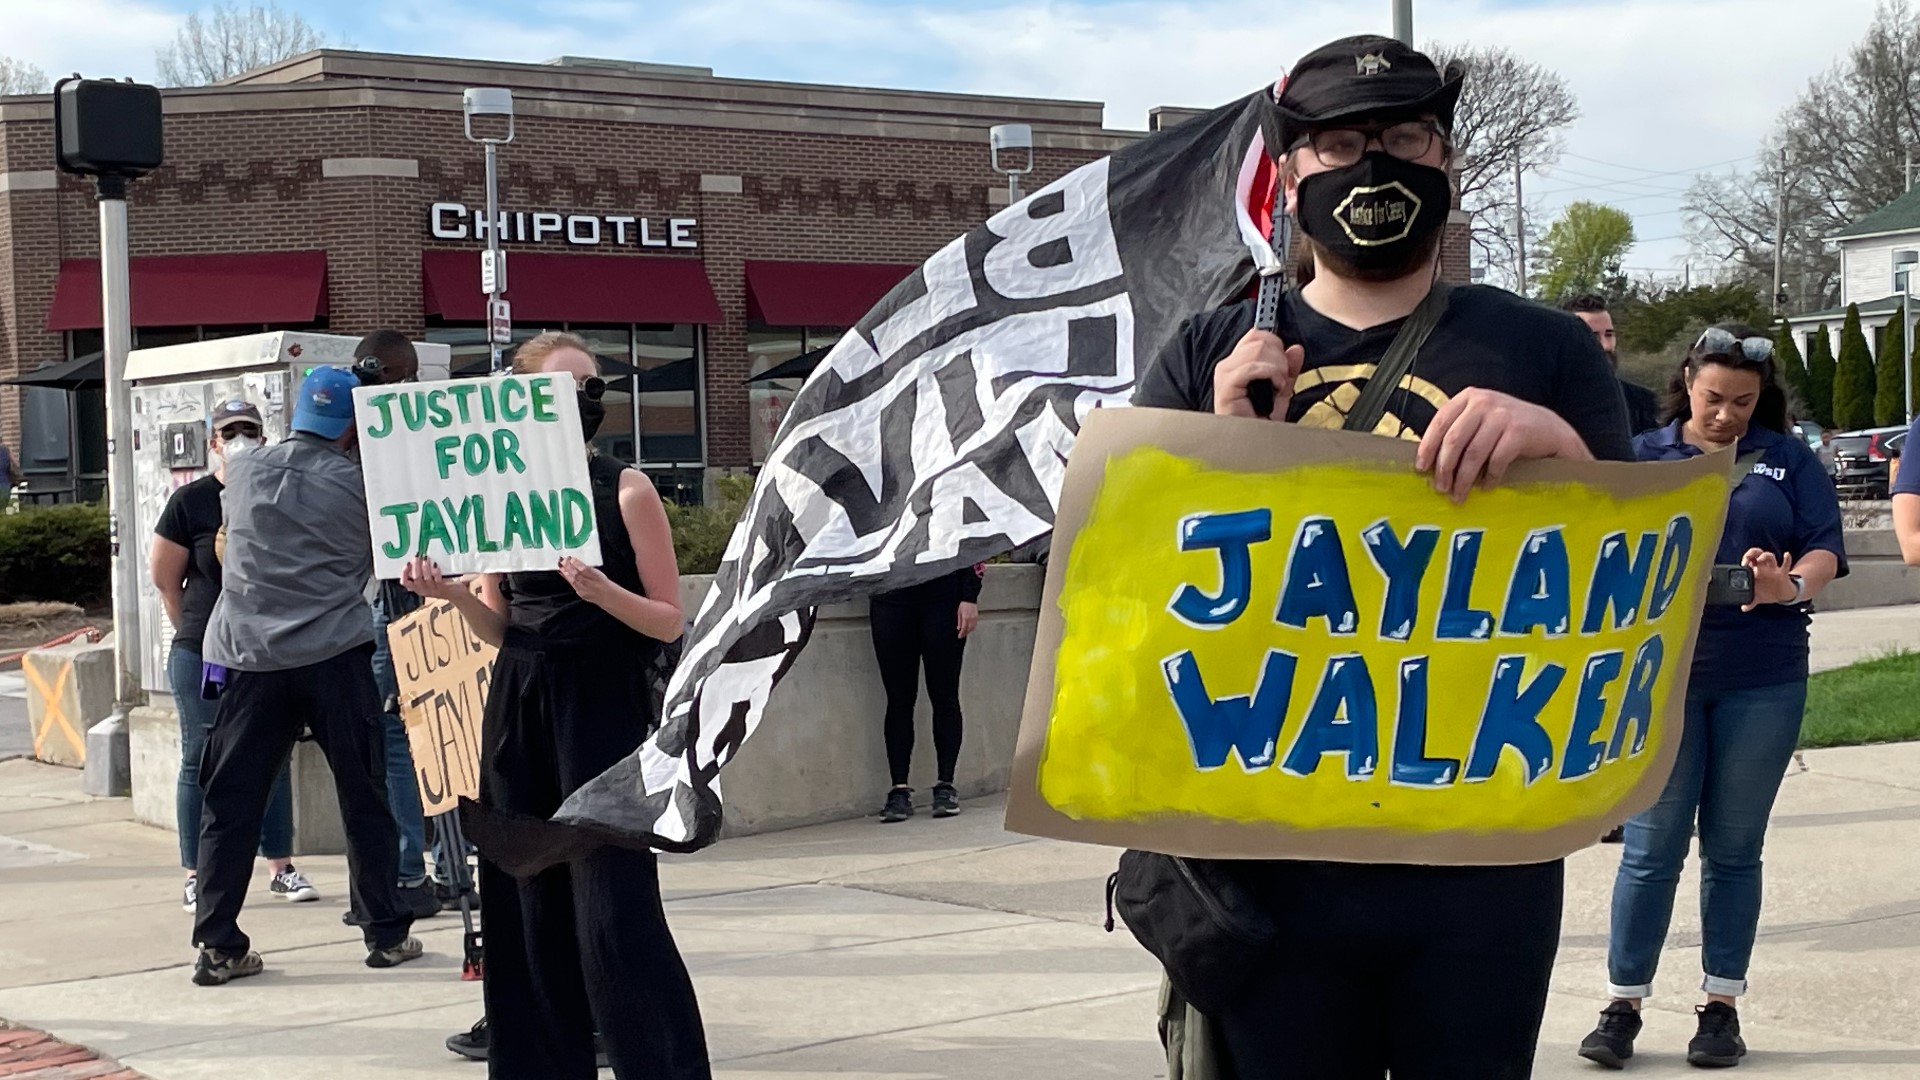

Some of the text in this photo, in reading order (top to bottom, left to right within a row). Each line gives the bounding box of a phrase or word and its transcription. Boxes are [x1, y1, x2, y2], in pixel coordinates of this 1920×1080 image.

[432, 202, 697, 248] CHIPOTLE
[367, 378, 559, 438] JUSTICE
[435, 428, 526, 479] FOR
[380, 487, 594, 559] JAYLAND
[1166, 508, 1694, 642] JAYLAND
[1160, 632, 1665, 788] WALKER
